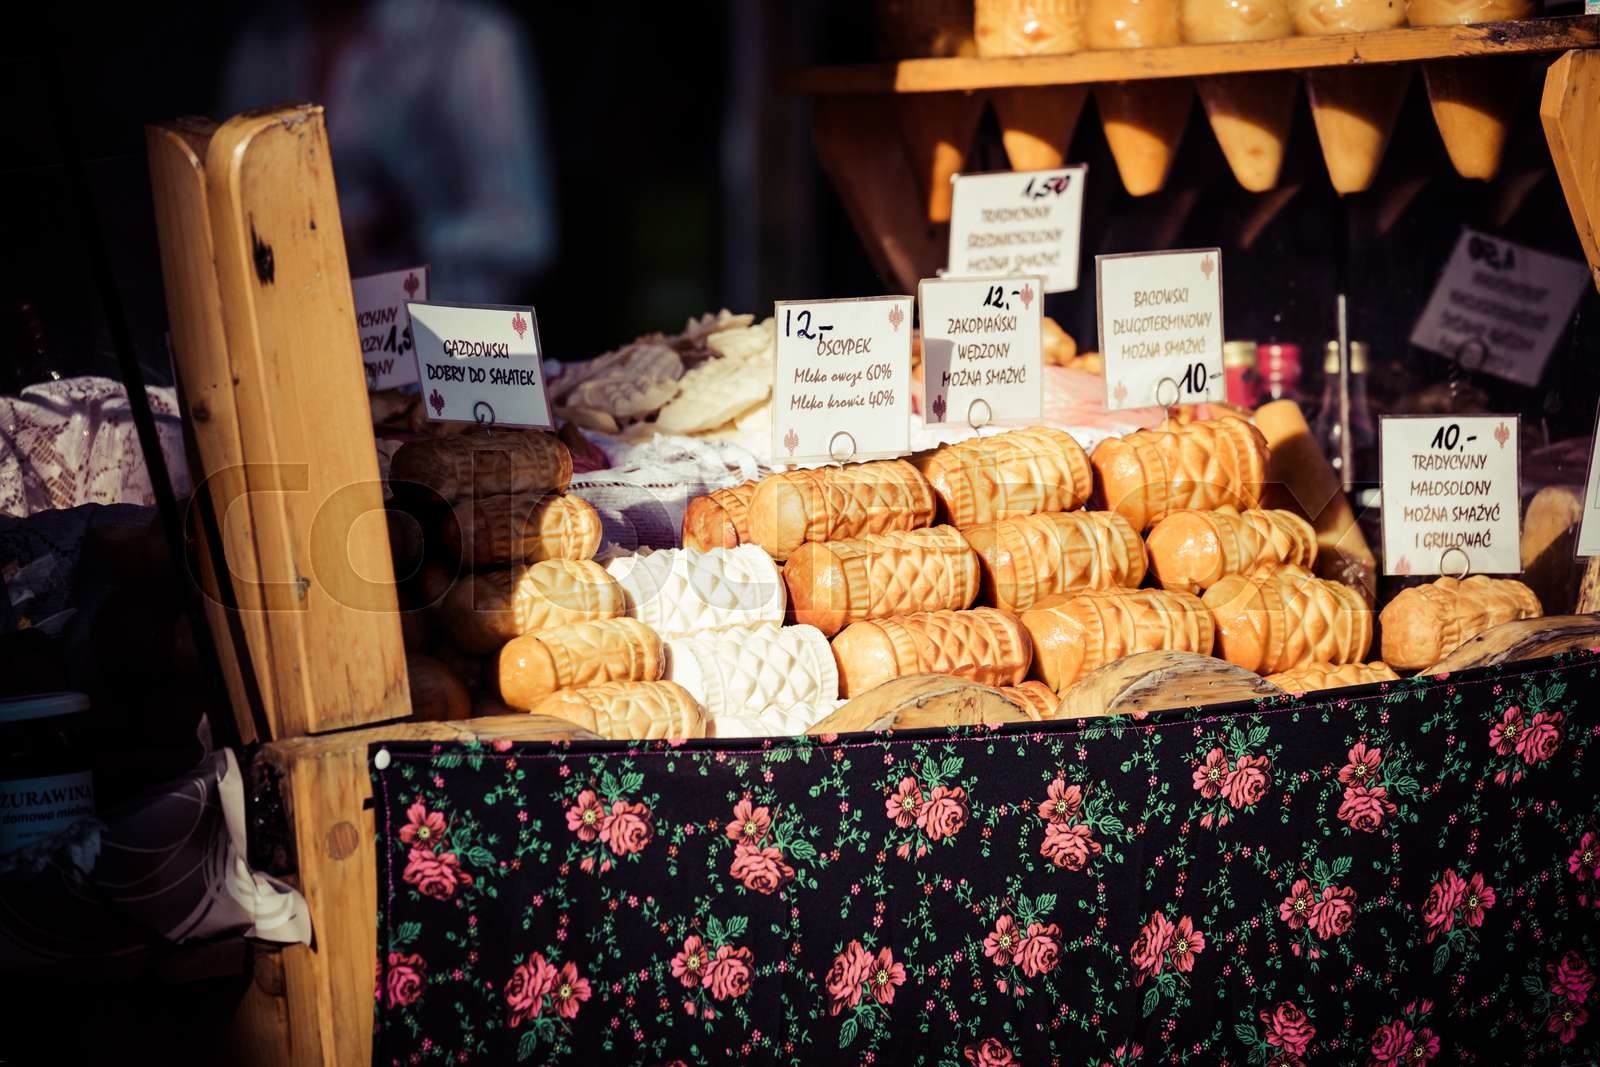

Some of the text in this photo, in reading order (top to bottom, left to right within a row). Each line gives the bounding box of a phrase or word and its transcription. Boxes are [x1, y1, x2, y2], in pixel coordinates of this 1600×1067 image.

[1133, 287, 1190, 308] BACOWSKI
[947, 314, 1018, 335] ZAKOPIAŃSKI
[1112, 311, 1213, 336] DŁUGOTERMINOWY
[443, 339, 509, 359] GAZDOWSKI
[816, 337, 872, 356] OSCYPEK
[957, 343, 1011, 362] WĘDZONY
[1121, 335, 1206, 360] MOŻNA SMAŻYĆ
[426, 363, 536, 385] DOBRY DO SAŁATEK
[794, 363, 892, 387] Mleko owcze 60%
[942, 364, 1027, 387] MOŻNA SMAŻYĆ
[790, 390, 895, 410] Mleko krowie 40%
[1431, 423, 1478, 453] 10,-
[1412, 454, 1488, 471] TRADYCYJNY
[1410, 479, 1492, 497] MAŁOSOLONY
[1403, 502, 1501, 522] MOŻNA SMAŻYĆ
[1423, 528, 1492, 549] GRILLOWAĆ
